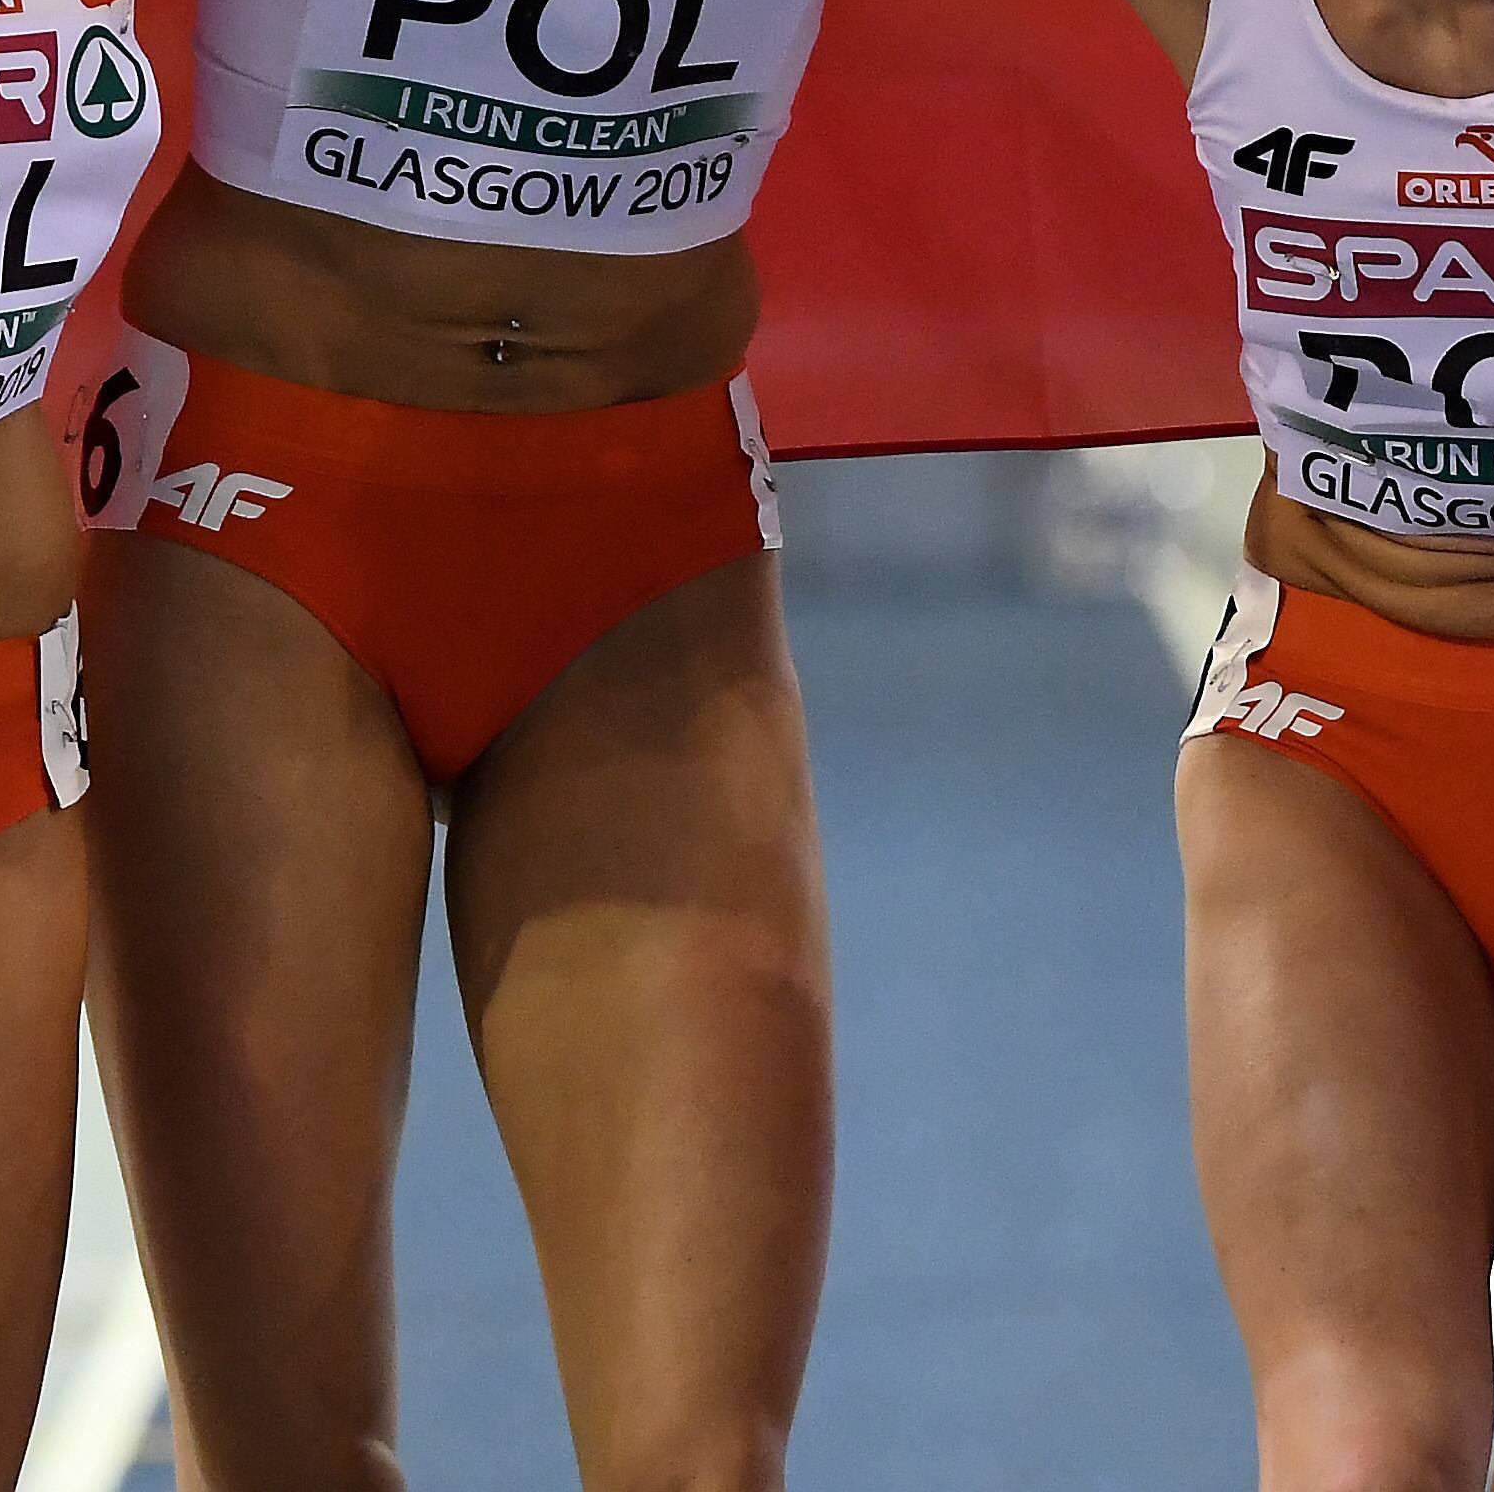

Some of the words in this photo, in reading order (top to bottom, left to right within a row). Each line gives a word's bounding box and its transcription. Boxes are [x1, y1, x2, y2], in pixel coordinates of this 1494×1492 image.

[398, 87, 411, 119] I
[423, 91, 523, 142] RUN
[305, 128, 622, 218] GLASGOW
[628, 153, 734, 217] 2019
[1233, 125, 1356, 197] 4F
[81, 366, 141, 518] 6
[1385, 440, 1478, 477] RUN
[149, 461, 294, 532] 4F
[1225, 680, 1345, 740] 4F
